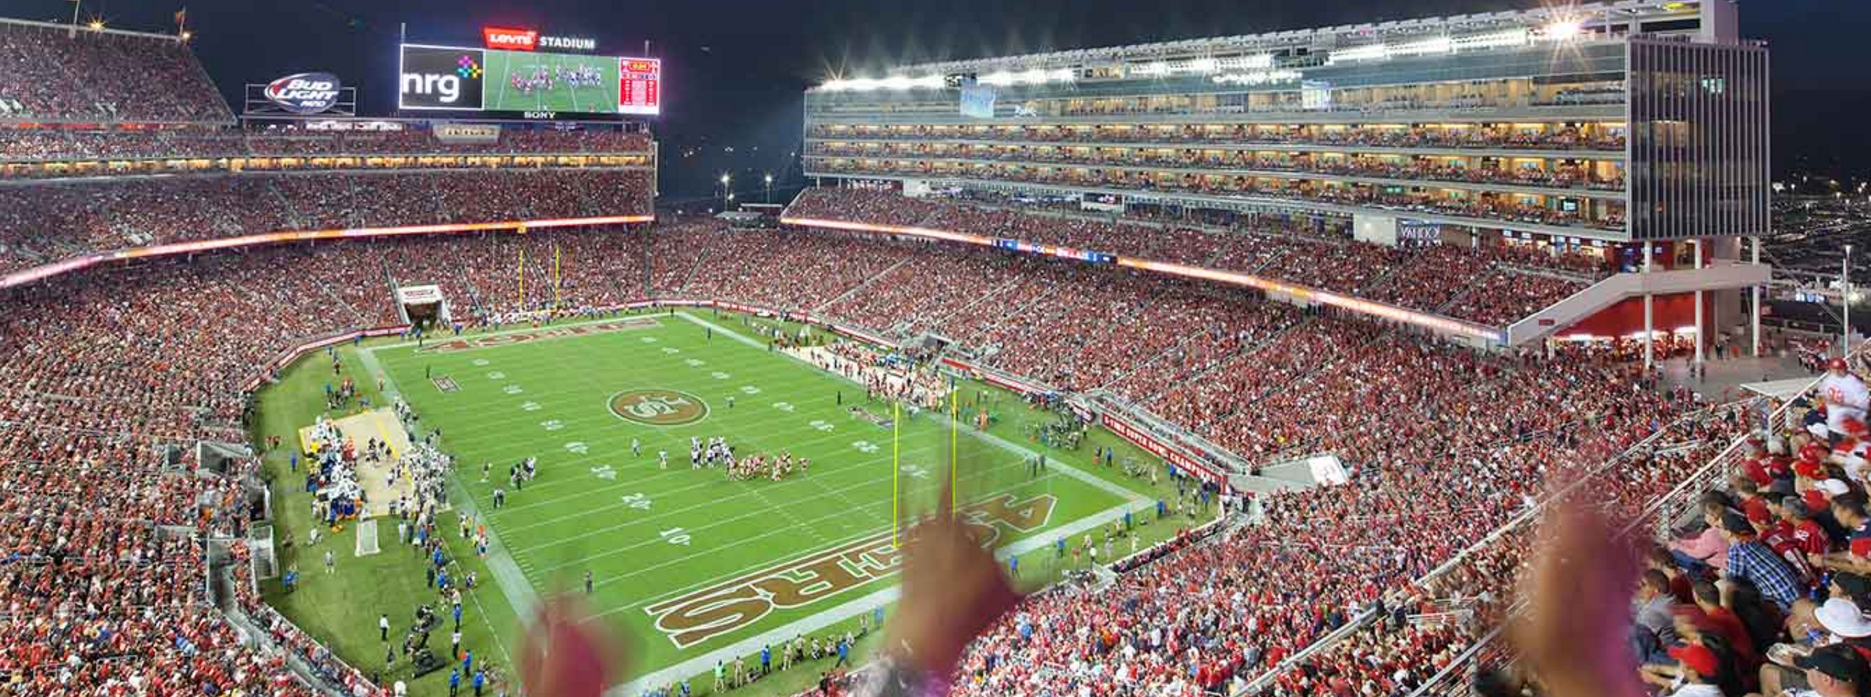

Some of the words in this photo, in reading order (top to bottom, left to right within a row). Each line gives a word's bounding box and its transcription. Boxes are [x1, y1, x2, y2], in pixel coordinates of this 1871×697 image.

[540, 36, 595, 48] STADIUM
[287, 79, 333, 90] BUD
[402, 72, 460, 102] nrg
[276, 87, 339, 100] LIGHT
[523, 111, 557, 119] SONY
[660, 527, 690, 546] 10
